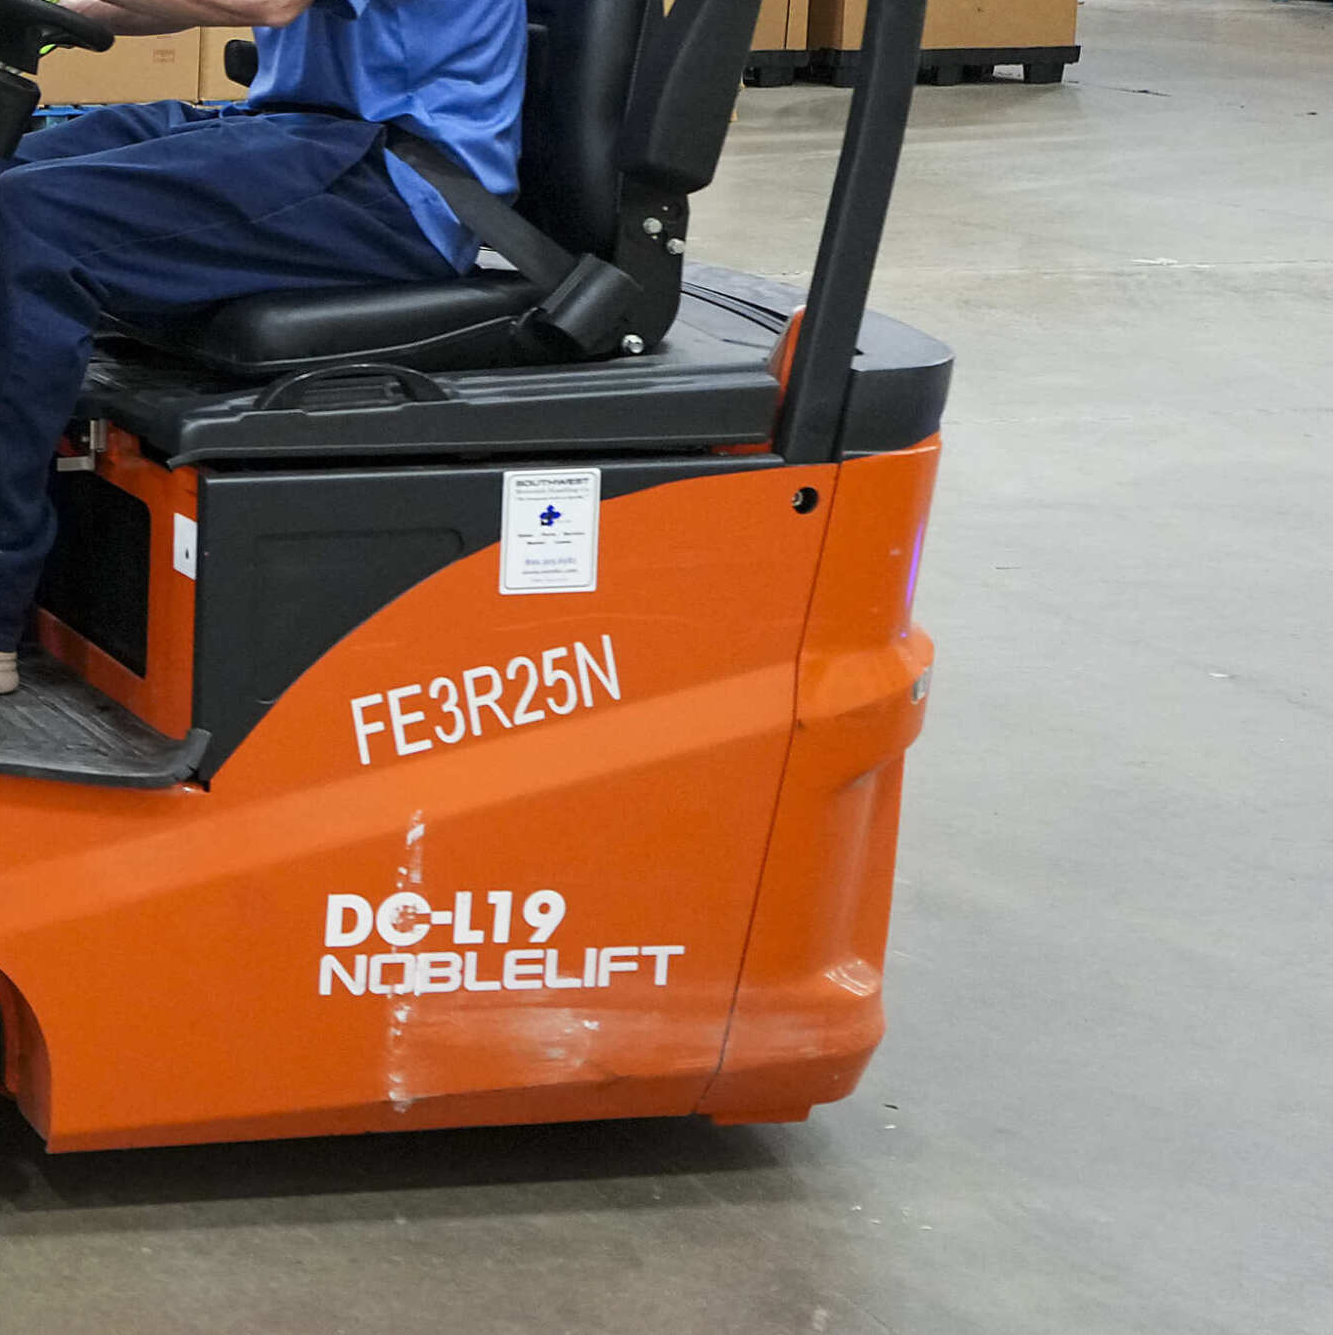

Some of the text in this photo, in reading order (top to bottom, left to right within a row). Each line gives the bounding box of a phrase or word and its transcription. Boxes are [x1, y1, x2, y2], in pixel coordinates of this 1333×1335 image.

[350, 634, 622, 765] FE3R25N
[323, 889, 567, 948] DC-L19
[318, 945, 686, 996] NOBLELIFT
